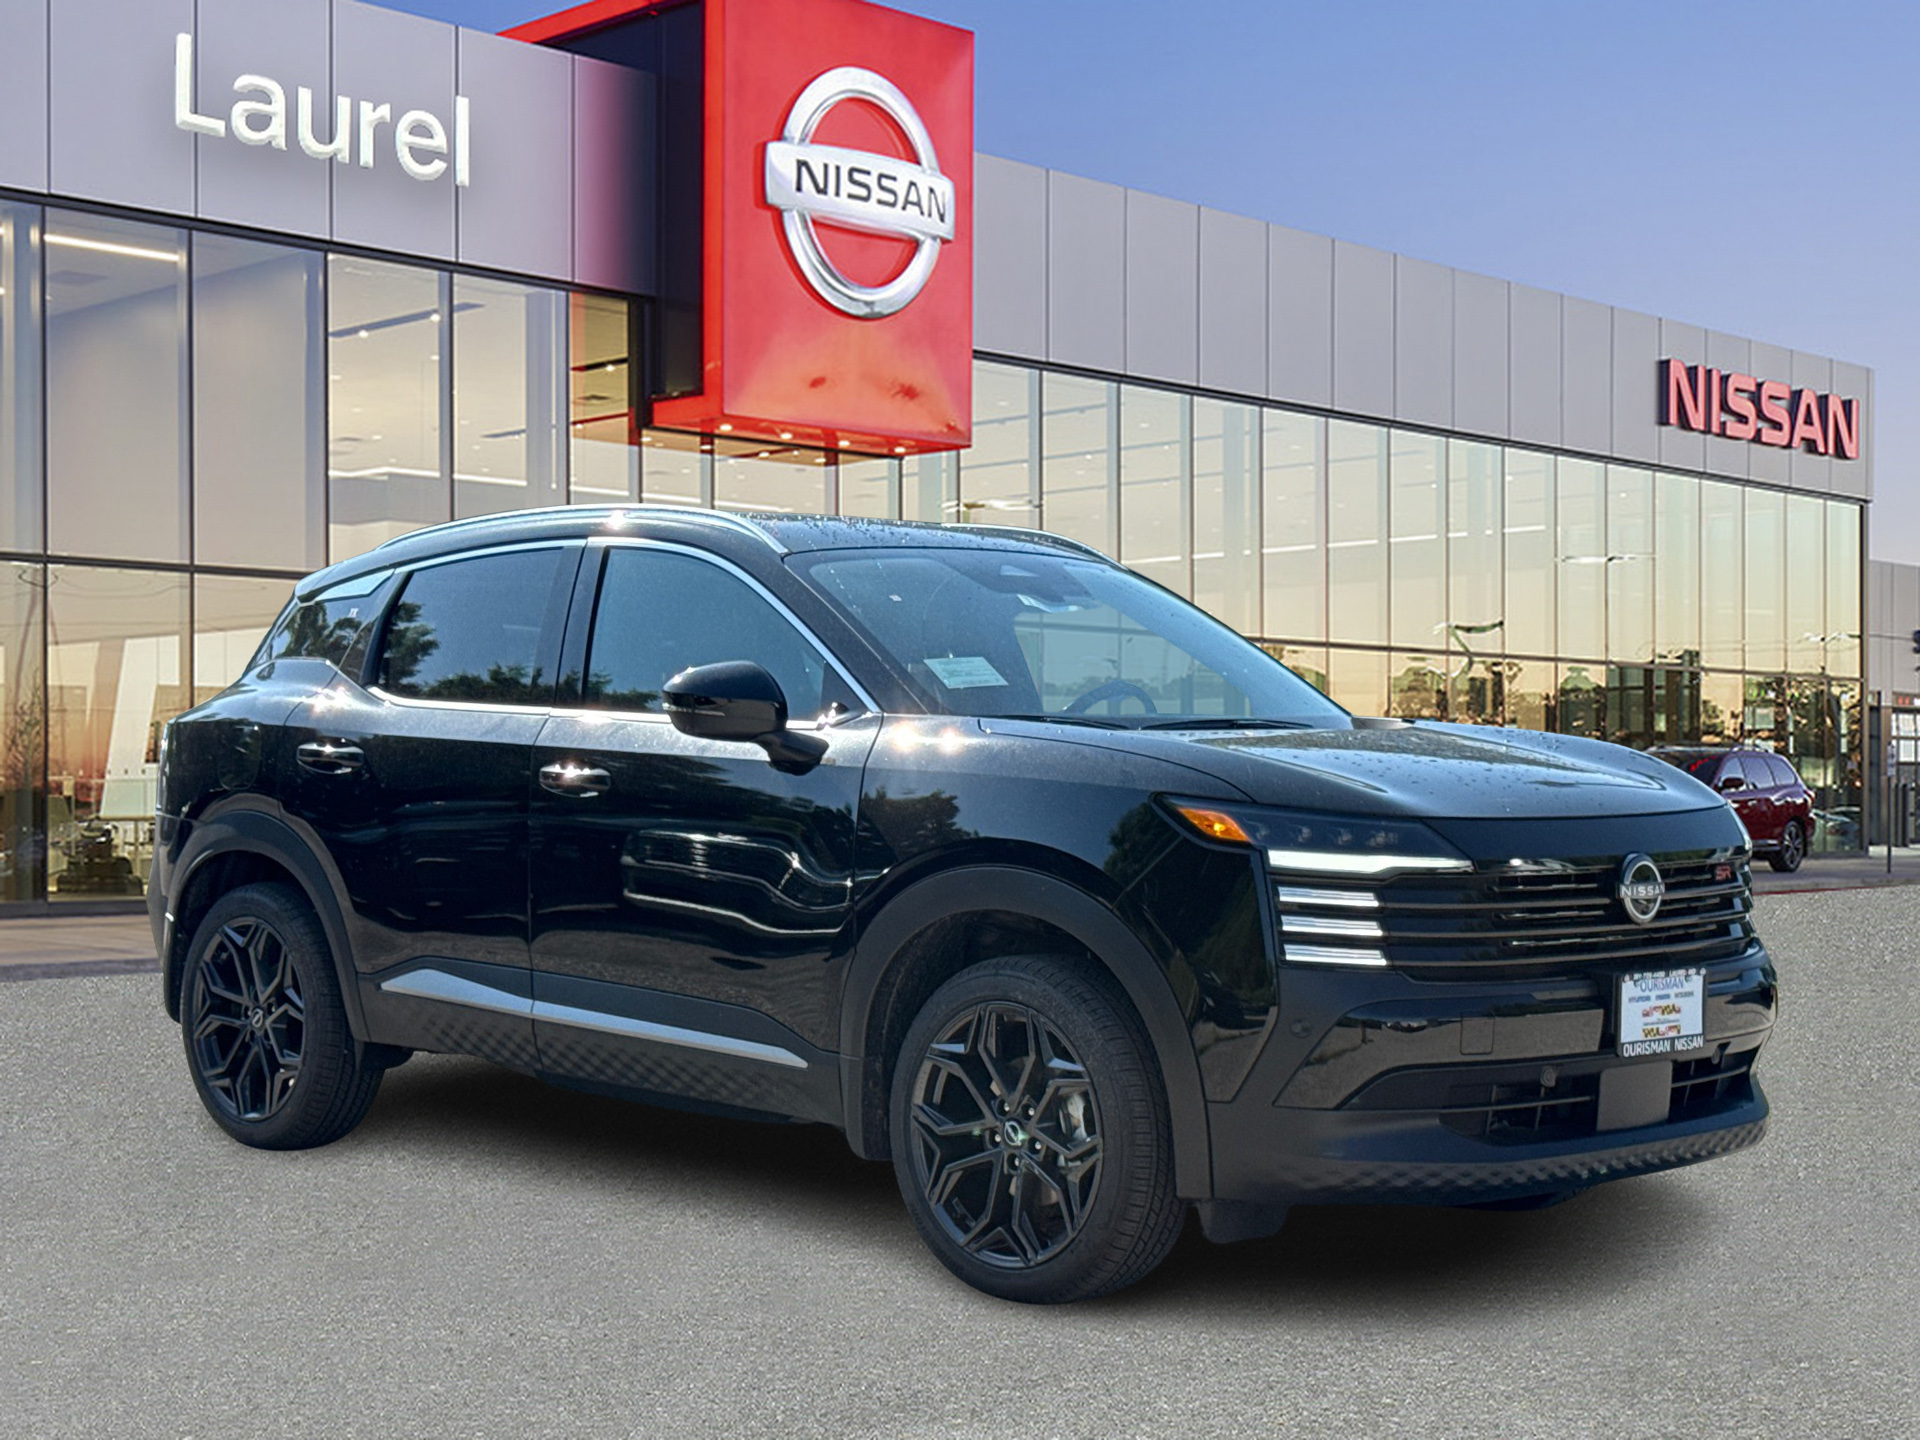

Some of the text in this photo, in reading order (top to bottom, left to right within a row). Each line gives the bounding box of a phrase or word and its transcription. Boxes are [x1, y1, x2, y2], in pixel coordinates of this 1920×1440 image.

[175, 32, 470, 188] Laurel
[795, 158, 946, 224] NISSAN
[1658, 357, 1860, 461] NISSAN
[1621, 884, 1666, 897] NISSAN
[1640, 977, 1684, 993] OURISMAN
[1623, 1035, 1704, 1057] OURISMAN NISSAN
